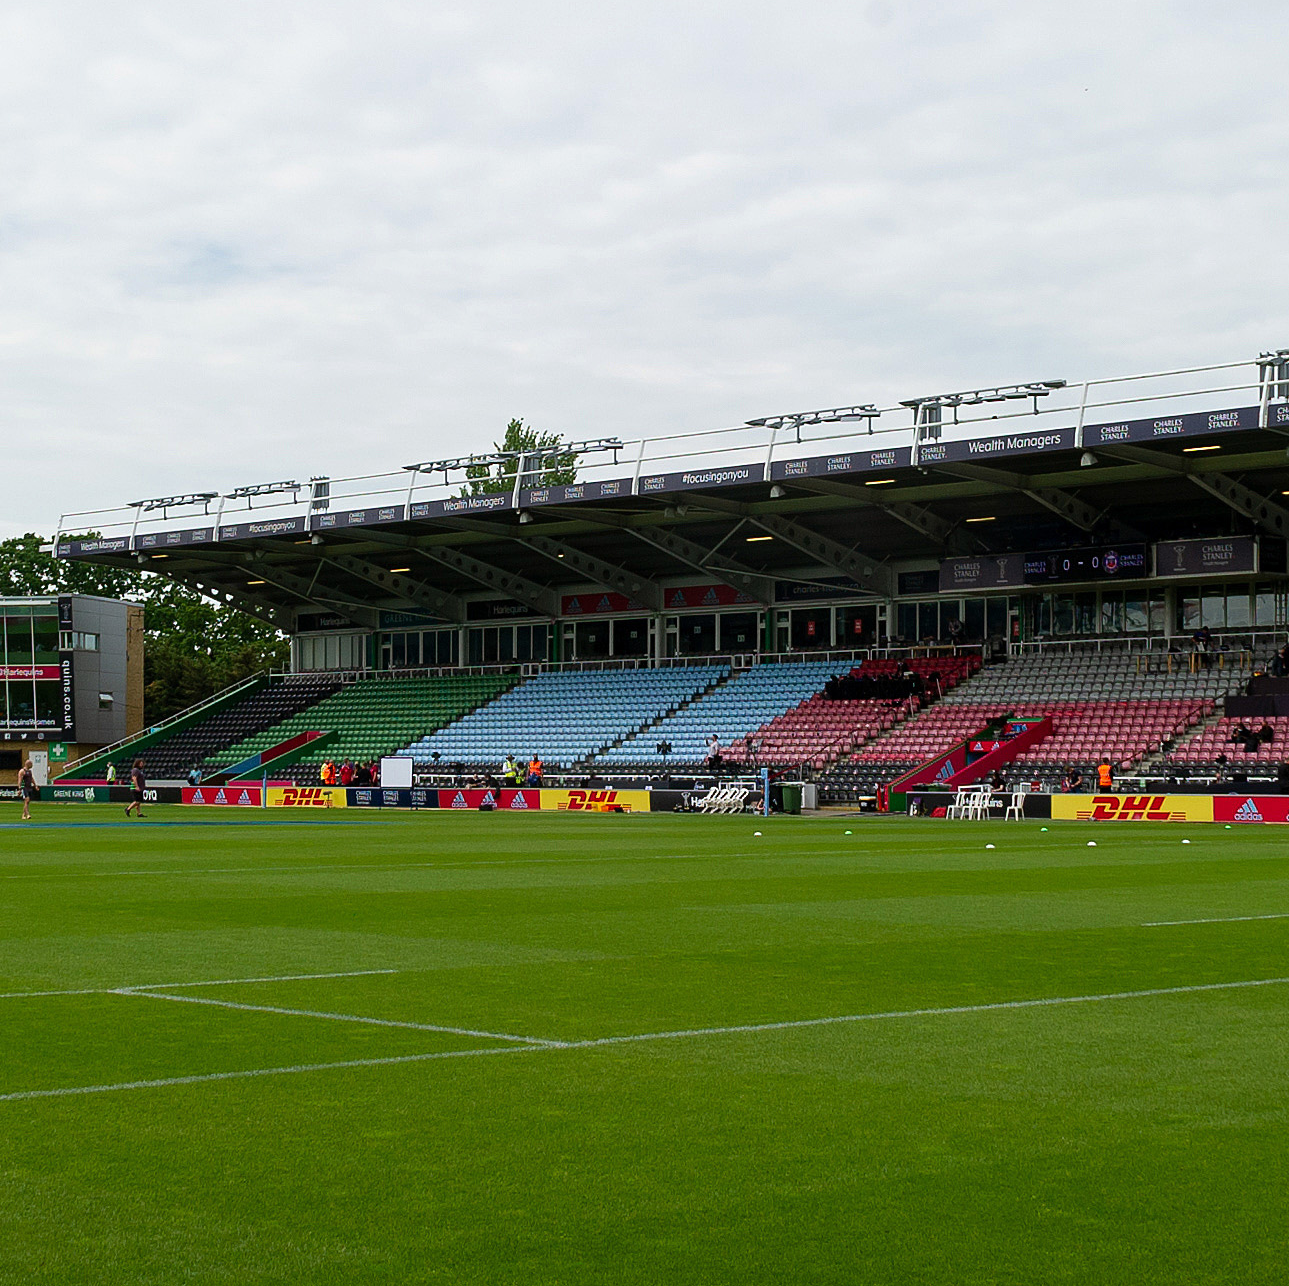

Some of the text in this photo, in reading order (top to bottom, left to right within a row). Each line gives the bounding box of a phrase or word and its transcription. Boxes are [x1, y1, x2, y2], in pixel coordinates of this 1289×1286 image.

[1209, 412, 1238, 423] CHARLES
[1153, 419, 1183, 429] CHARLES
[1208, 419, 1238, 429] STANLEY
[1100, 425, 1129, 435] CHARLES
[1153, 426, 1182, 435] STANLEY
[1100, 432, 1128, 442] STANLEY
[968, 434, 1061, 454] Wealth Managers
[682, 469, 749, 485] #focusingonyou
[1202, 543, 1234, 554] CHARLES
[1202, 552, 1233, 562] STANLEY
[1062, 559, 1071, 571] 0
[1091, 556, 1100, 569] 0
[62, 660, 74, 729] quins.co.uk
[283, 788, 325, 806] DHL
[568, 790, 622, 811] DHL
[1091, 796, 1172, 820] DHL
[1234, 813, 1263, 821] adidas
